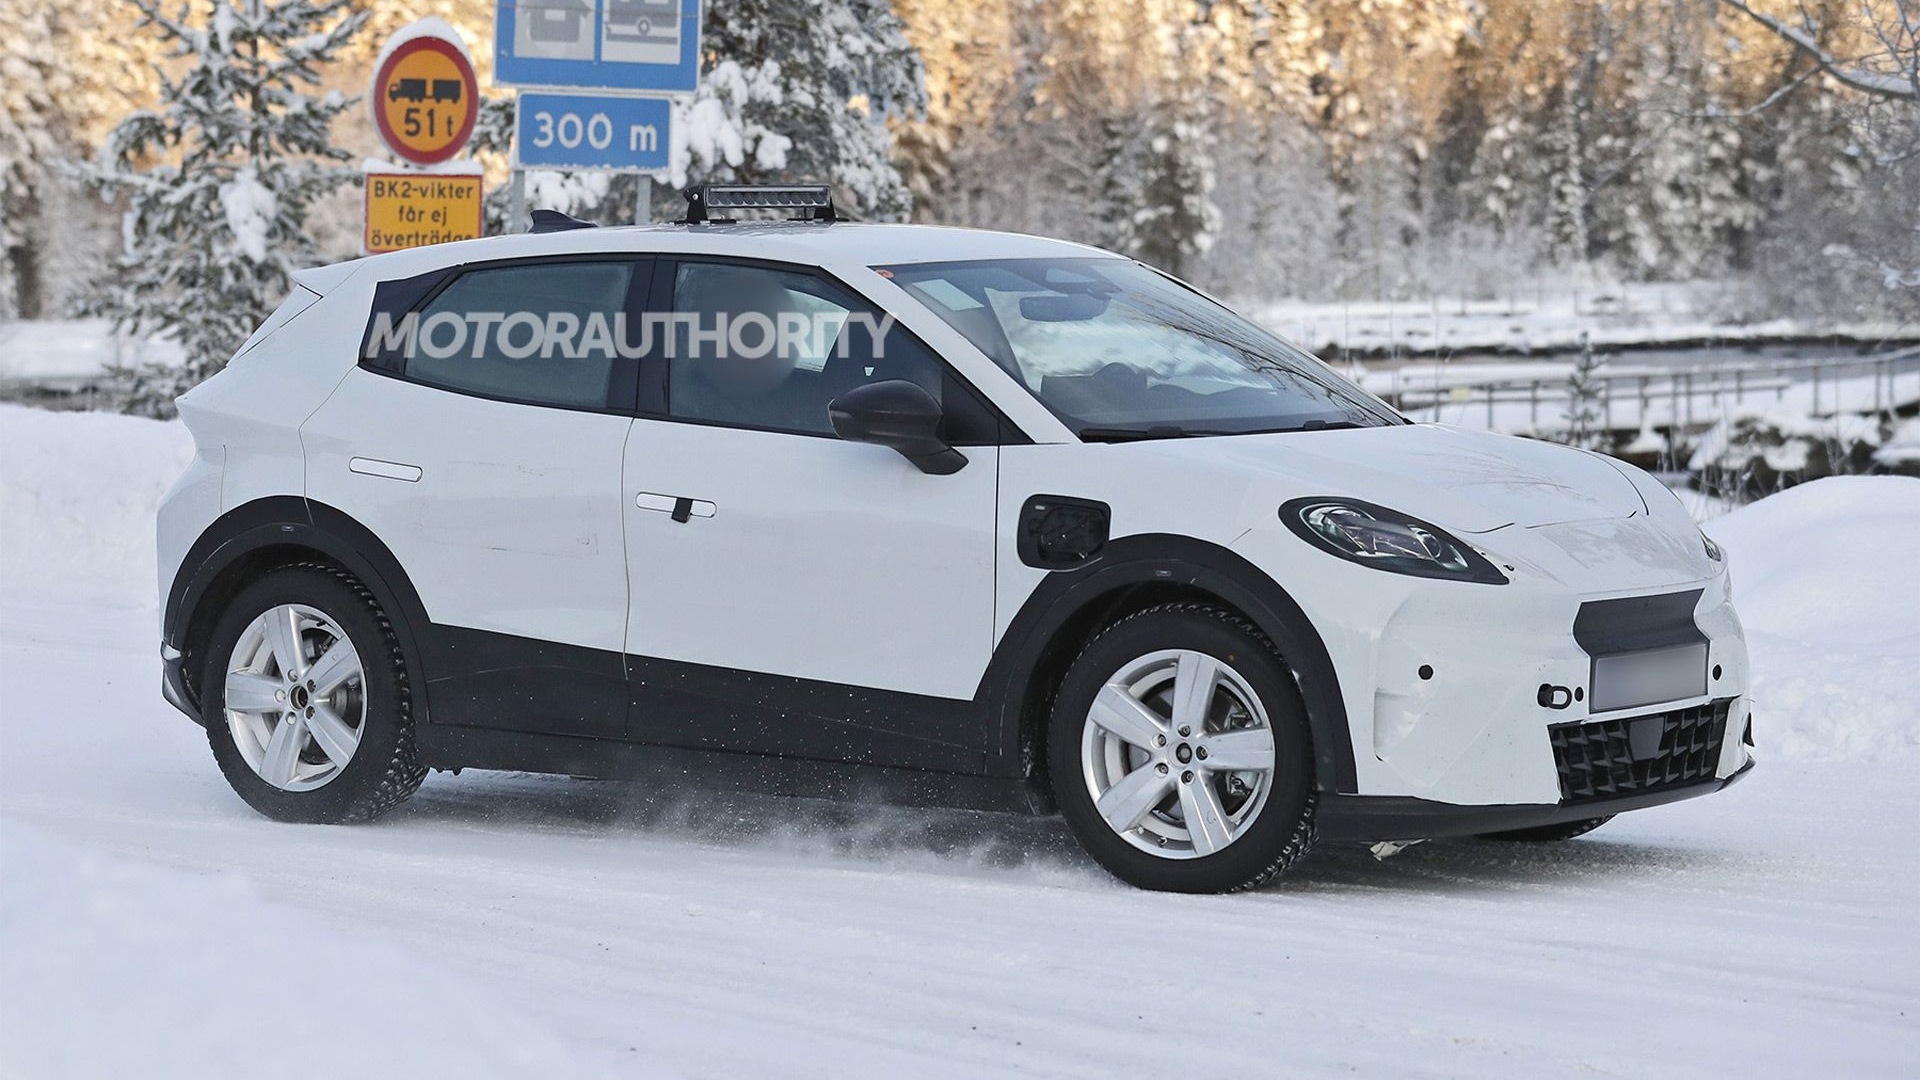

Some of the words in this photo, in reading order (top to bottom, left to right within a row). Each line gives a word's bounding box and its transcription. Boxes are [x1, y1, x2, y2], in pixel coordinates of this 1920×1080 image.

[404, 108, 435, 137] 51
[446, 116, 454, 137] t
[533, 112, 613, 149] 300
[630, 123, 657, 152] m
[374, 181, 473, 199] BK2-vikter
[399, 205, 425, 223] får
[431, 206, 447, 227] ej
